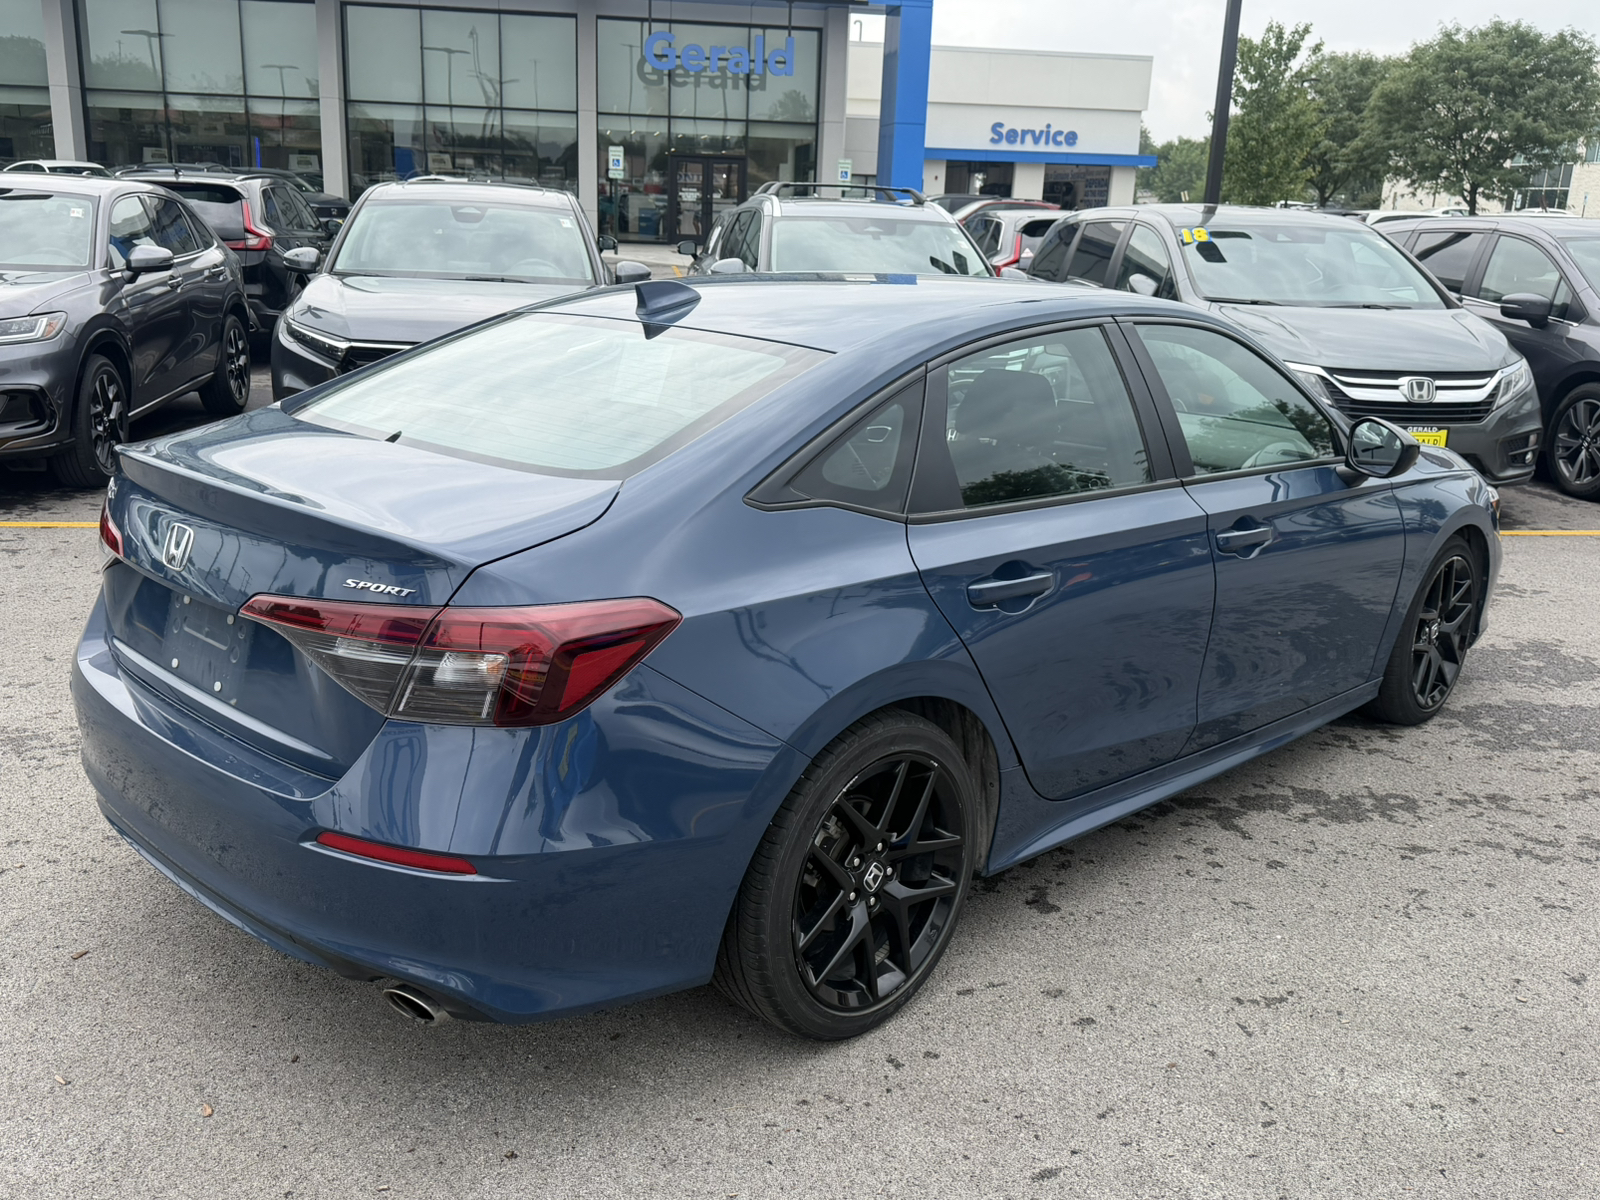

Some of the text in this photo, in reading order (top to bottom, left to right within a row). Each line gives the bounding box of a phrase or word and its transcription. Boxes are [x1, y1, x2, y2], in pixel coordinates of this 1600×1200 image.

[645, 31, 795, 76] Gerald
[989, 122, 1078, 146] Service
[1181, 227, 1209, 243] 18
[342, 578, 417, 597] SPORT
